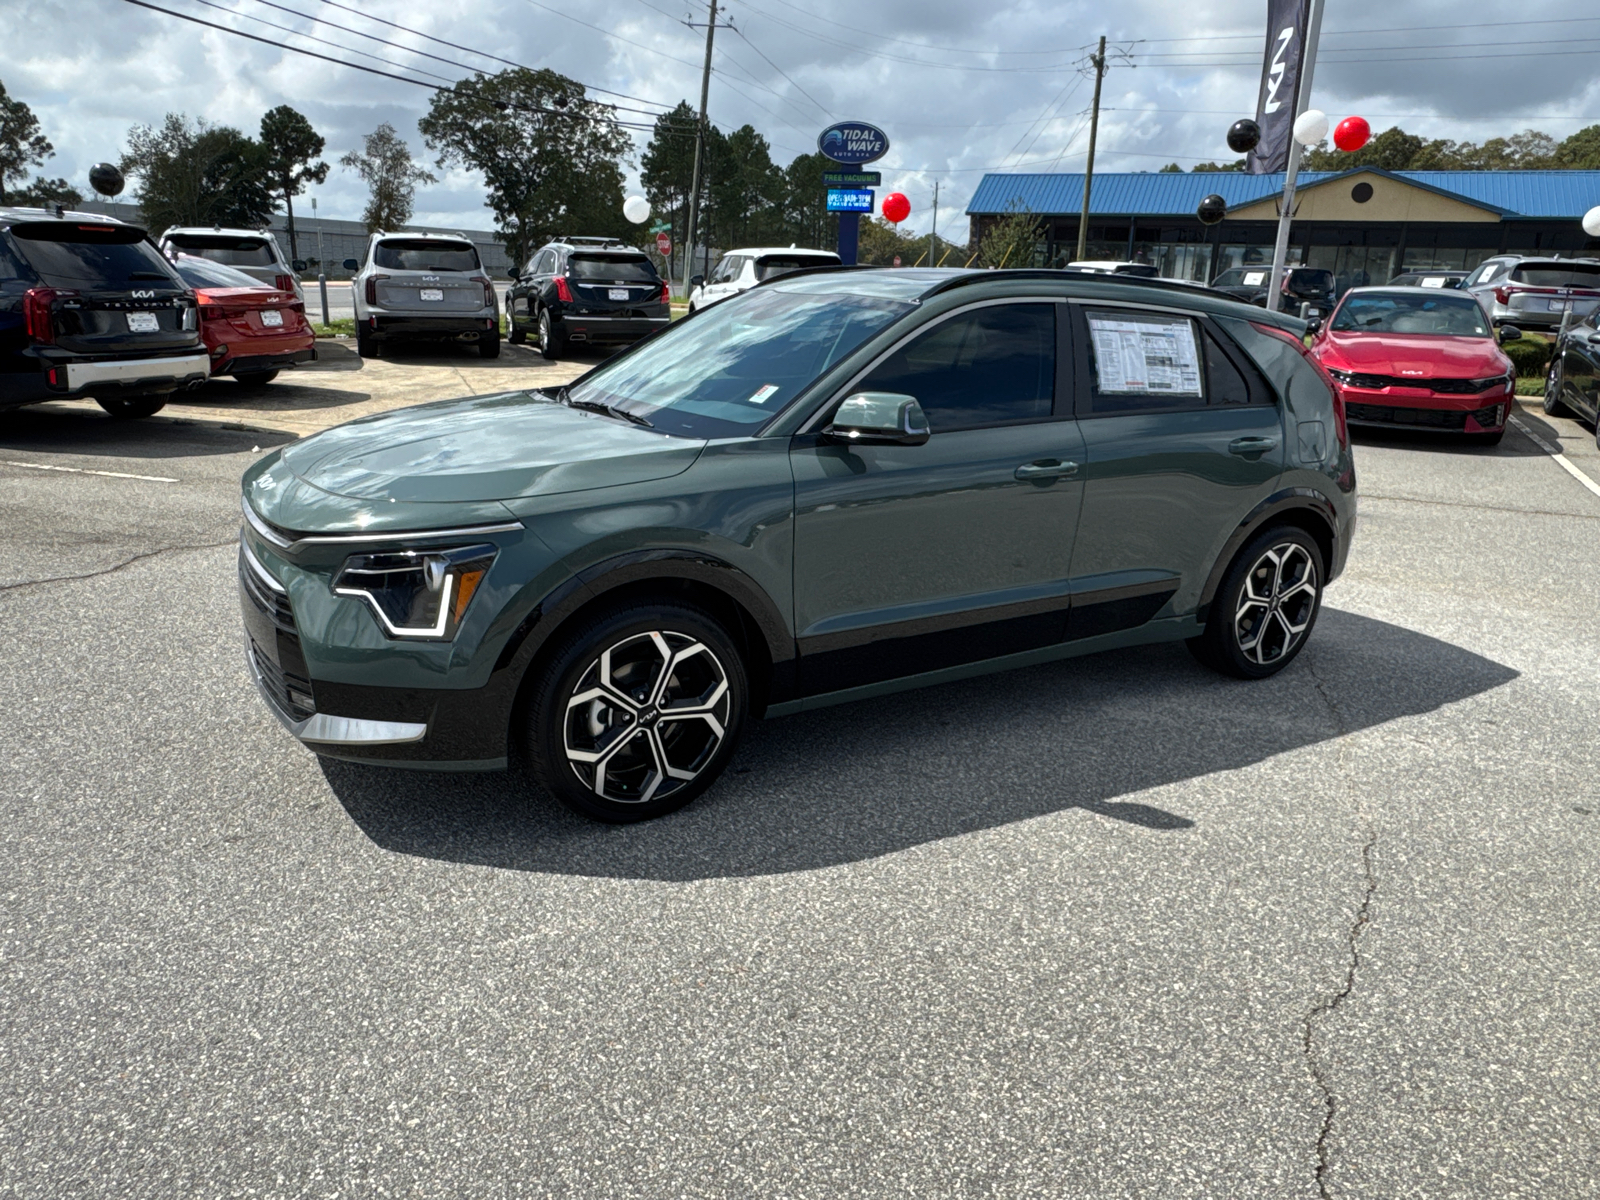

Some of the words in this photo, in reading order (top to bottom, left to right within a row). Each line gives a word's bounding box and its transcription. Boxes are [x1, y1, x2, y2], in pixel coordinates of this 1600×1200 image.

[1265, 27, 1294, 114] KIA
[843, 130, 875, 140] TIDAL
[848, 142, 881, 151] WAVE
[131, 290, 155, 299] KIA
